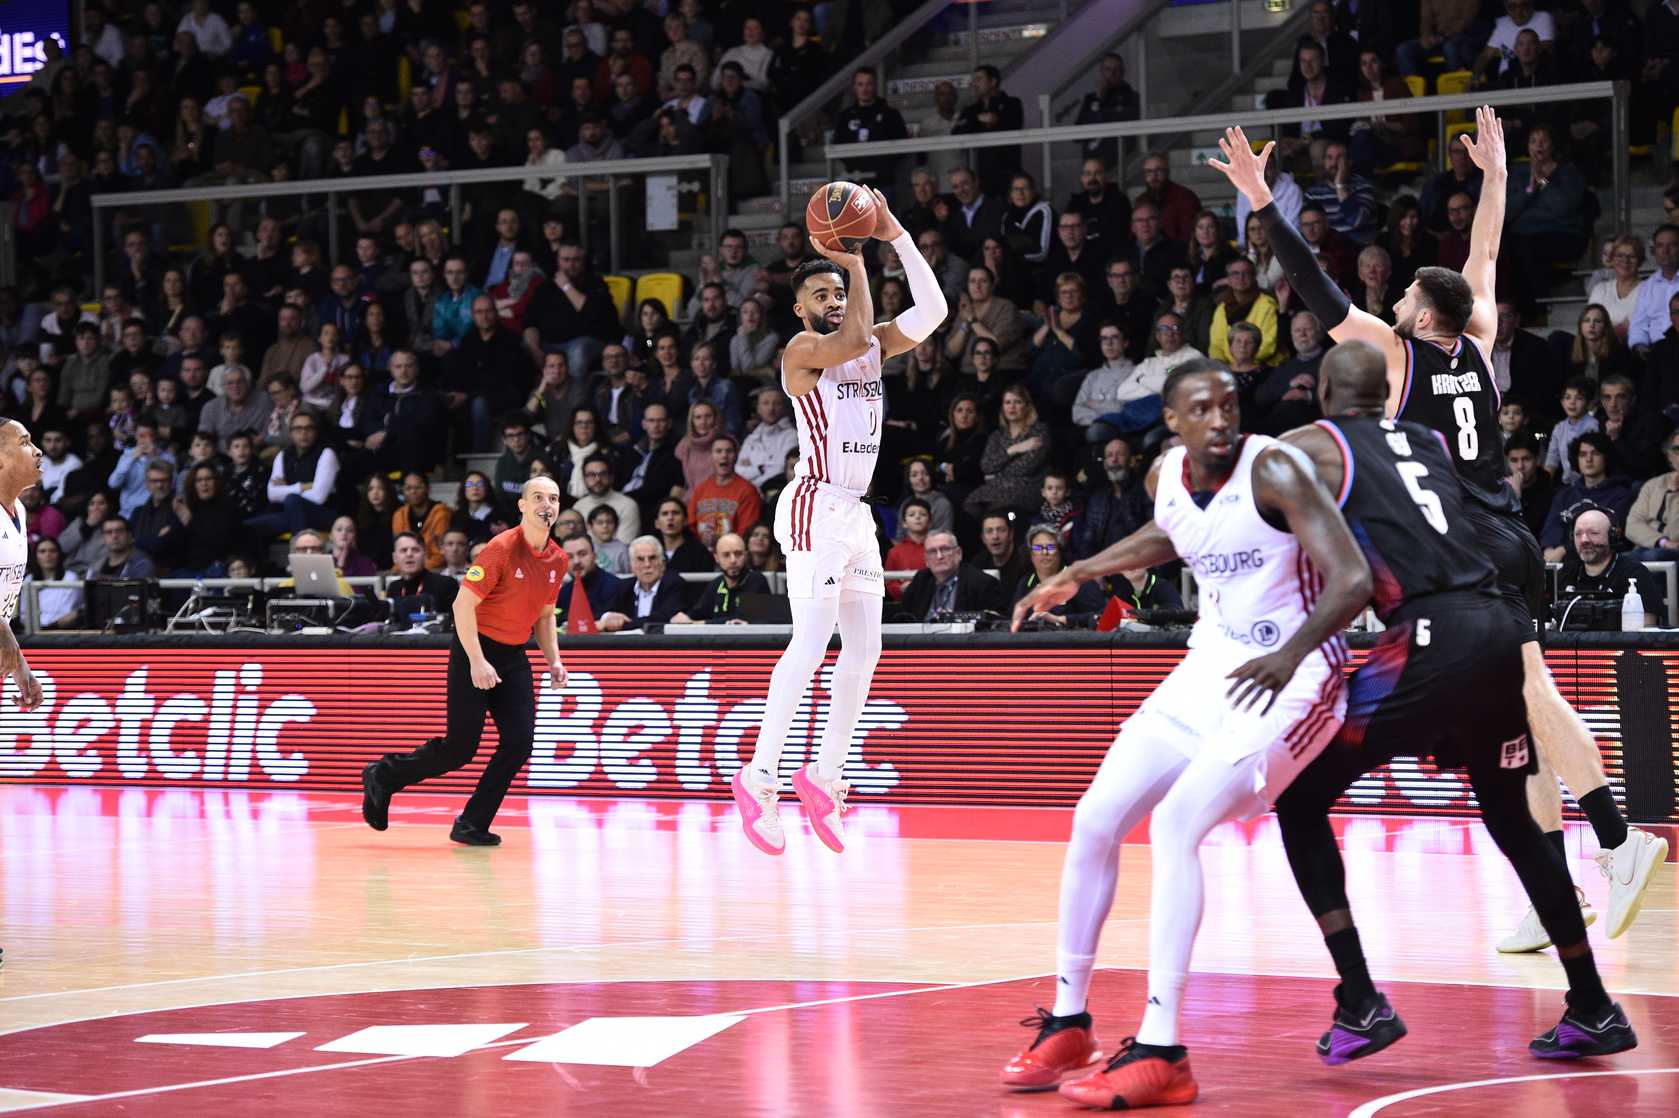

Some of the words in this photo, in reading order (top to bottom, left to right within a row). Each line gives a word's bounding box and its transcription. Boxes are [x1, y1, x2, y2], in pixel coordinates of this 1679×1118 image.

[1452, 396, 1479, 461] 8
[1395, 461, 1449, 535] 5
[1415, 618, 1431, 646] 5
[0, 663, 318, 781] Betclic
